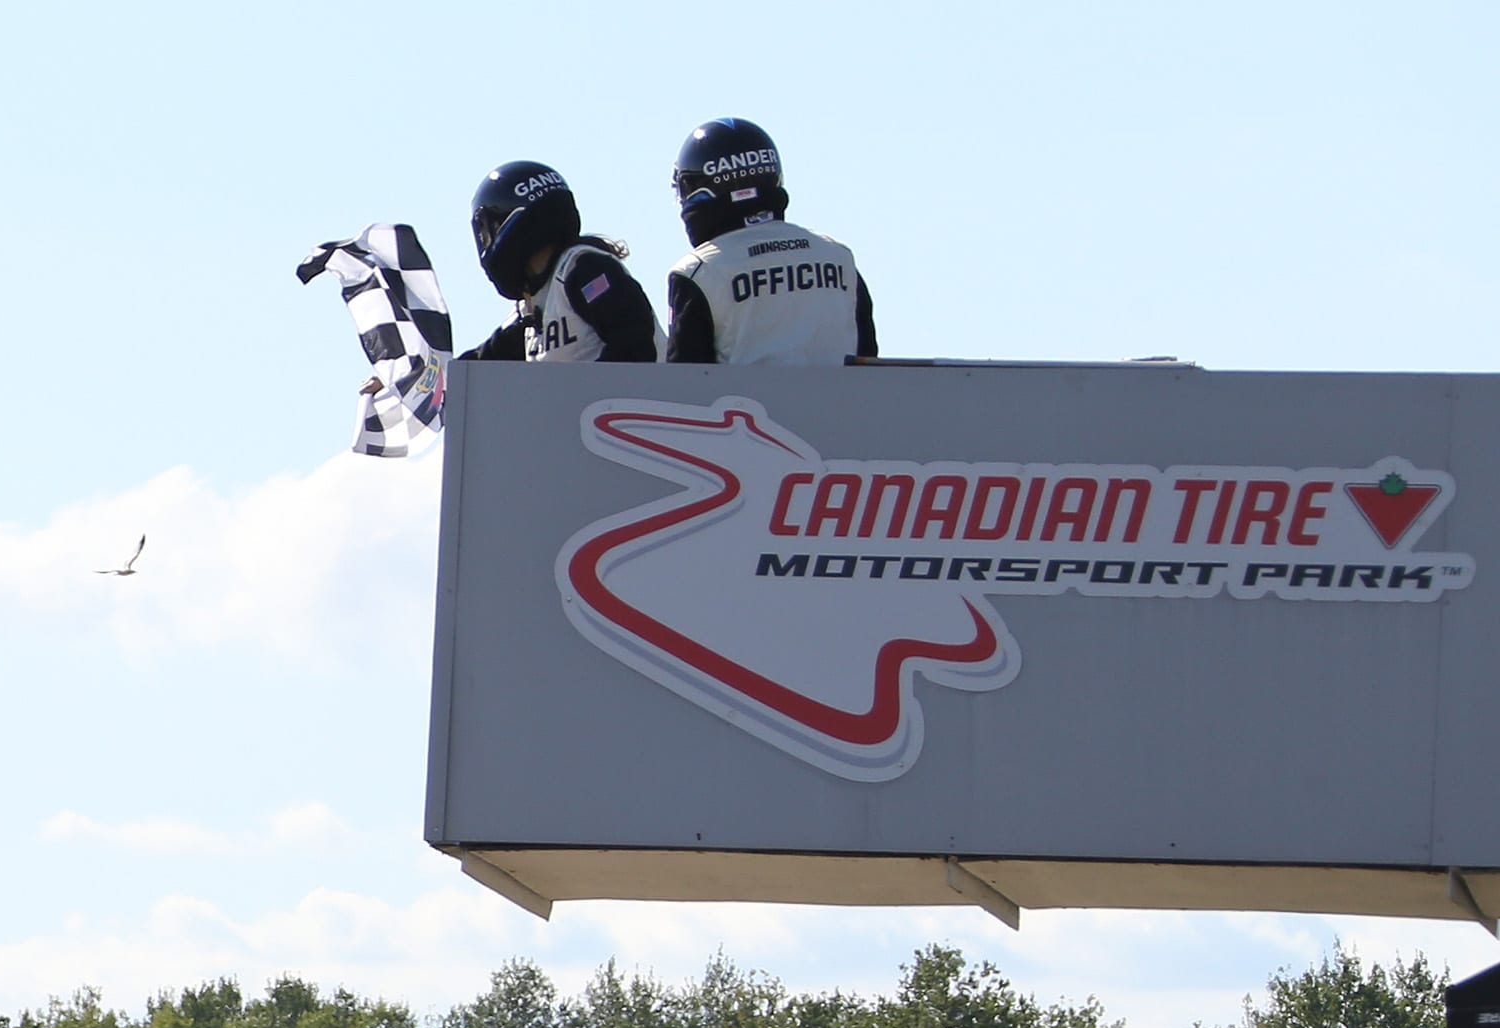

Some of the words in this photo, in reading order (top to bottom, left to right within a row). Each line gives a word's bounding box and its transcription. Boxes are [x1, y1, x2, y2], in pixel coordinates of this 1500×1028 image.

[703, 148, 778, 175] GANDER
[765, 239, 810, 253] NASCAR
[731, 262, 848, 303] OFFICIAL
[769, 473, 1152, 543] CANADIAN
[1172, 479, 1334, 546] TIRE
[755, 554, 1228, 585] MOTORSPORT
[1242, 563, 1436, 589] PARK
